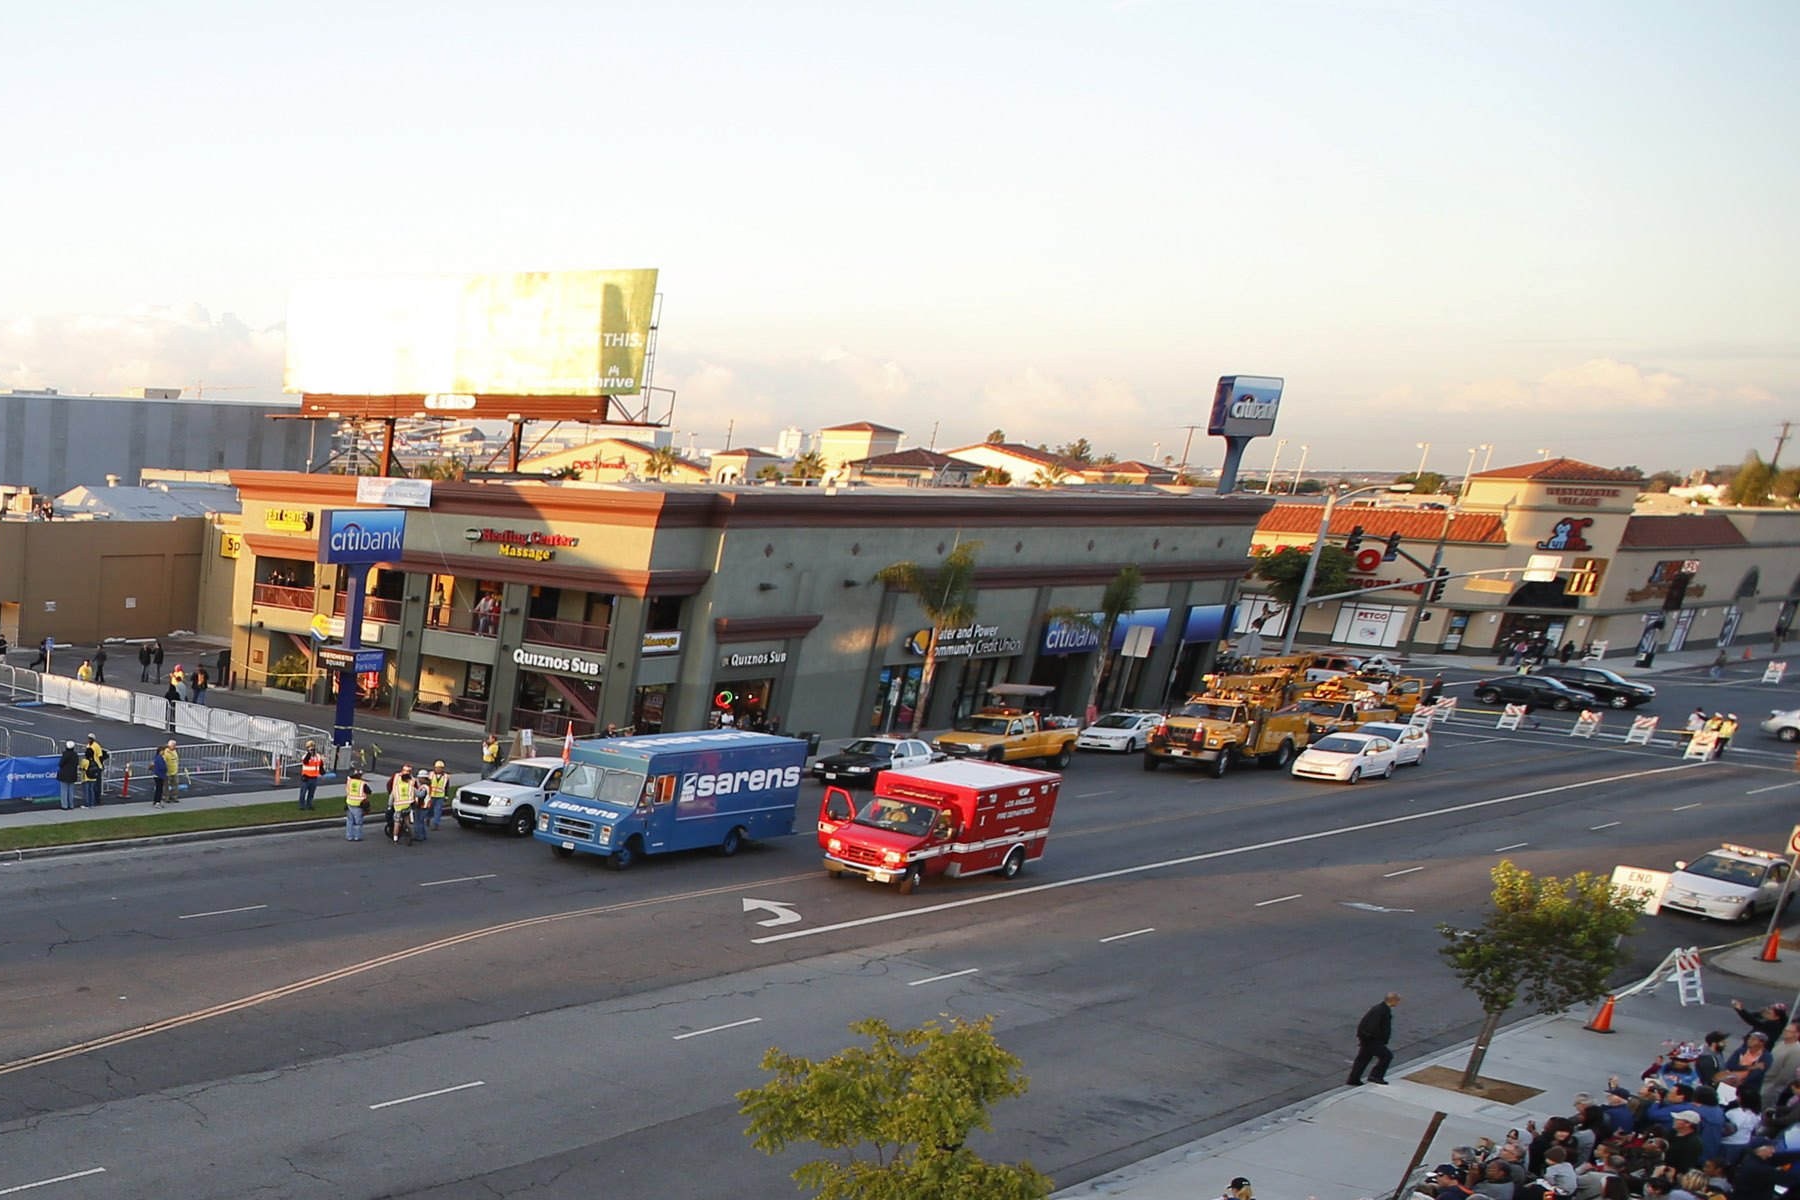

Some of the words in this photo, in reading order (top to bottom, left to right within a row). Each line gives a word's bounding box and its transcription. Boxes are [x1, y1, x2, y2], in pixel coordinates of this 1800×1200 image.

[603, 333, 643, 347] THIS.
[1231, 397, 1278, 419] citibank
[1558, 497, 1598, 506] VILLAGE
[265, 509, 281, 520] TEST
[282, 510, 309, 522] CENTER
[331, 524, 401, 551] citibank
[483, 528, 528, 546] Healing
[531, 531, 575, 546] Center
[499, 544, 551, 561] Massage
[1358, 612, 1389, 620] PETCO
[956, 625, 973, 639] and
[974, 624, 1000, 638] Power
[935, 641, 975, 658] ommunity
[975, 639, 999, 653] Credit
[1000, 636, 1021, 652] Union
[356, 652, 384, 661] Customer
[355, 662, 377, 671] Parking
[26, 772, 44, 780] Warner
[45, 771, 57, 779] Cabl
[697, 766, 800, 797] sarens
[1005, 799, 1015, 808] LOS
[1015, 796, 1035, 806] ANGELES
[558, 800, 620, 819] sarens
[997, 811, 1008, 820] FIRE
[1008, 806, 1037, 818] DEPARTMENT
[1628, 871, 1653, 884] END
